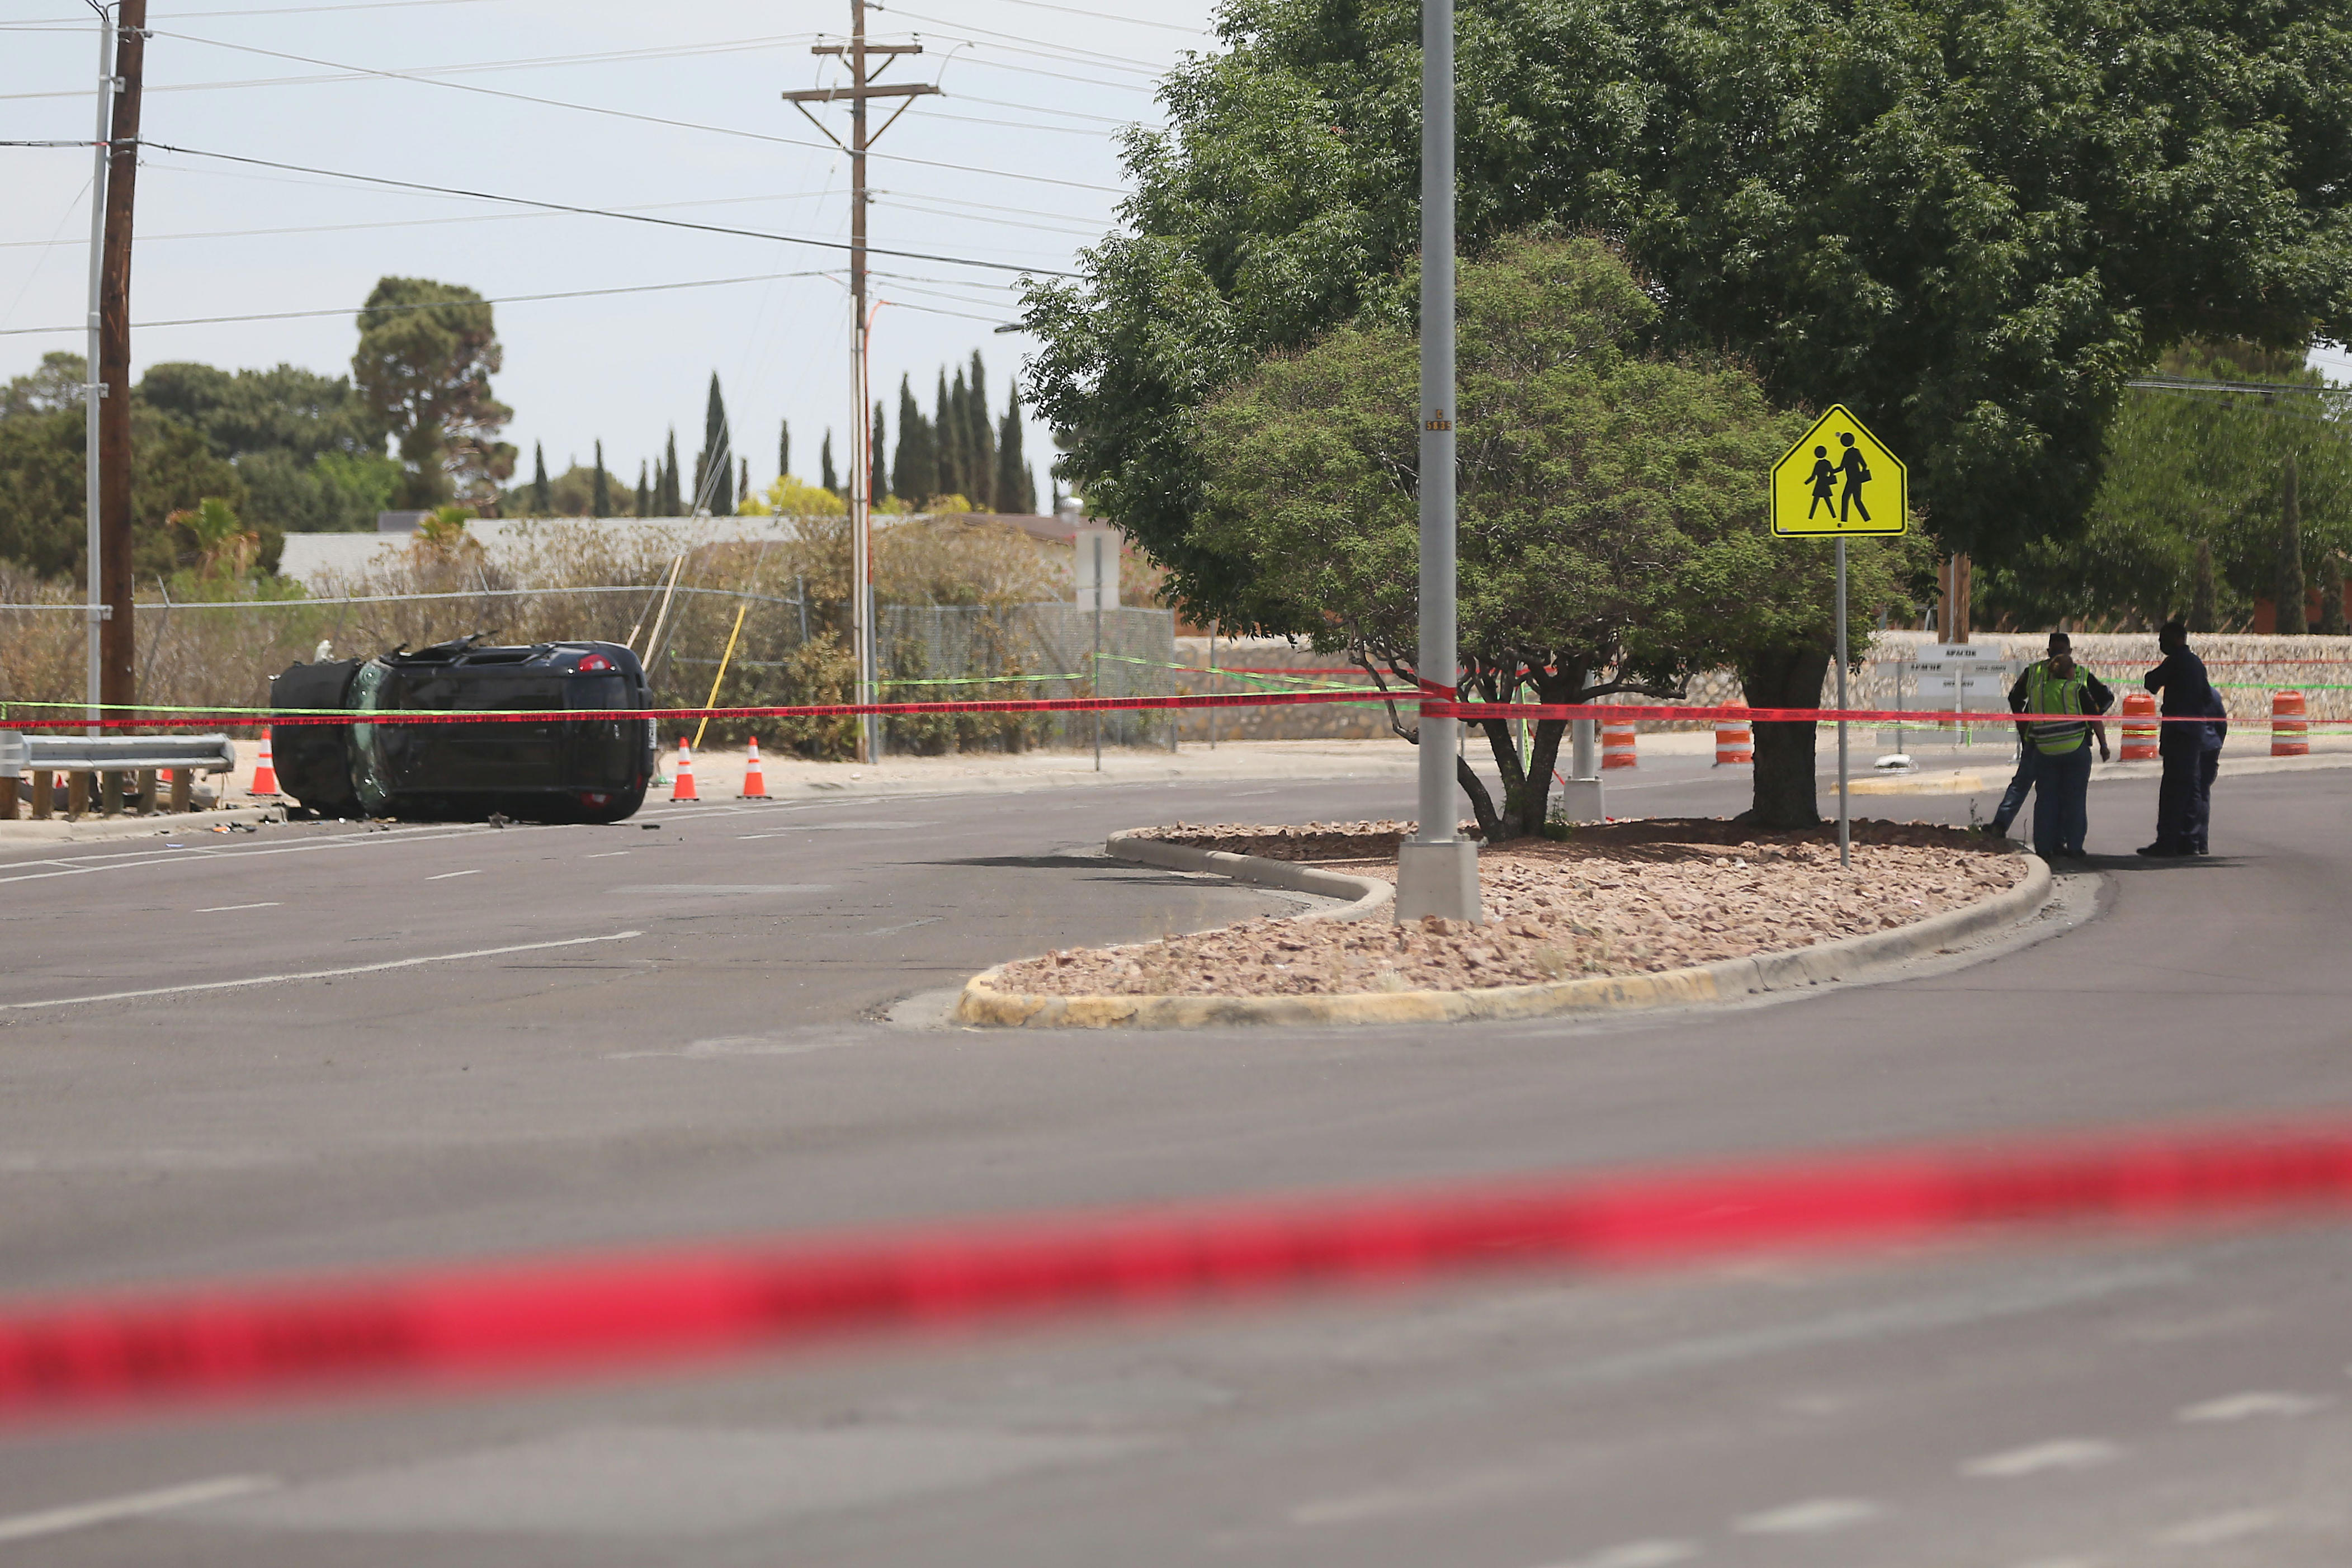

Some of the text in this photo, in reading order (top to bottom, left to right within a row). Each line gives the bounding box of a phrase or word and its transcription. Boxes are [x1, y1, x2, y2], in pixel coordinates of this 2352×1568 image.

[1427, 421, 1452, 430] 5835
[1050, 698, 1167, 710] CRIME SCENE DO NOT CROSS
[918, 705, 945, 713] CROSS
